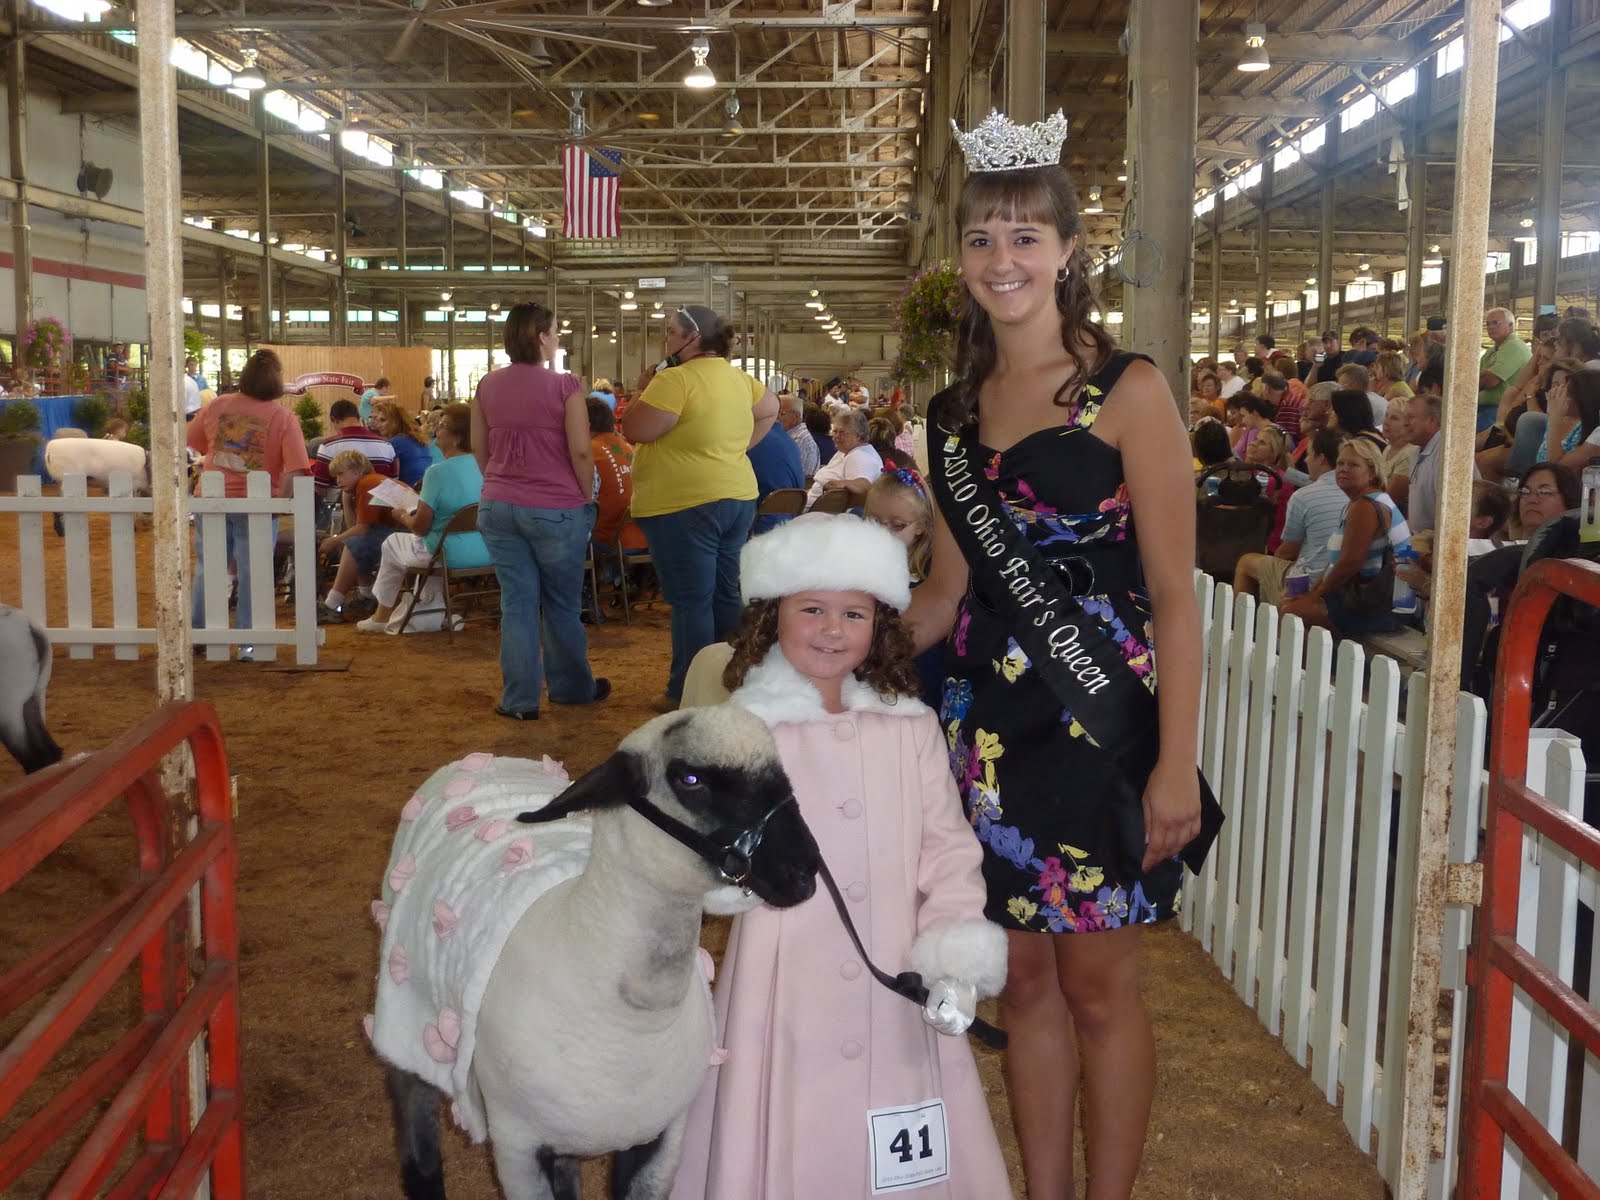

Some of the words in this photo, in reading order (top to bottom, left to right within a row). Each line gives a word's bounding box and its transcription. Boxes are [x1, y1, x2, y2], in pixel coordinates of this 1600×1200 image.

[304, 377, 321, 386] Ohio
[322, 375, 340, 384] State
[341, 376, 356, 386] Fair
[943, 447, 978, 502] 2010
[966, 504, 1006, 557] Ohio
[998, 557, 1059, 627] Fair's
[1047, 624, 1111, 695] Queen
[889, 1123, 933, 1163] 41
